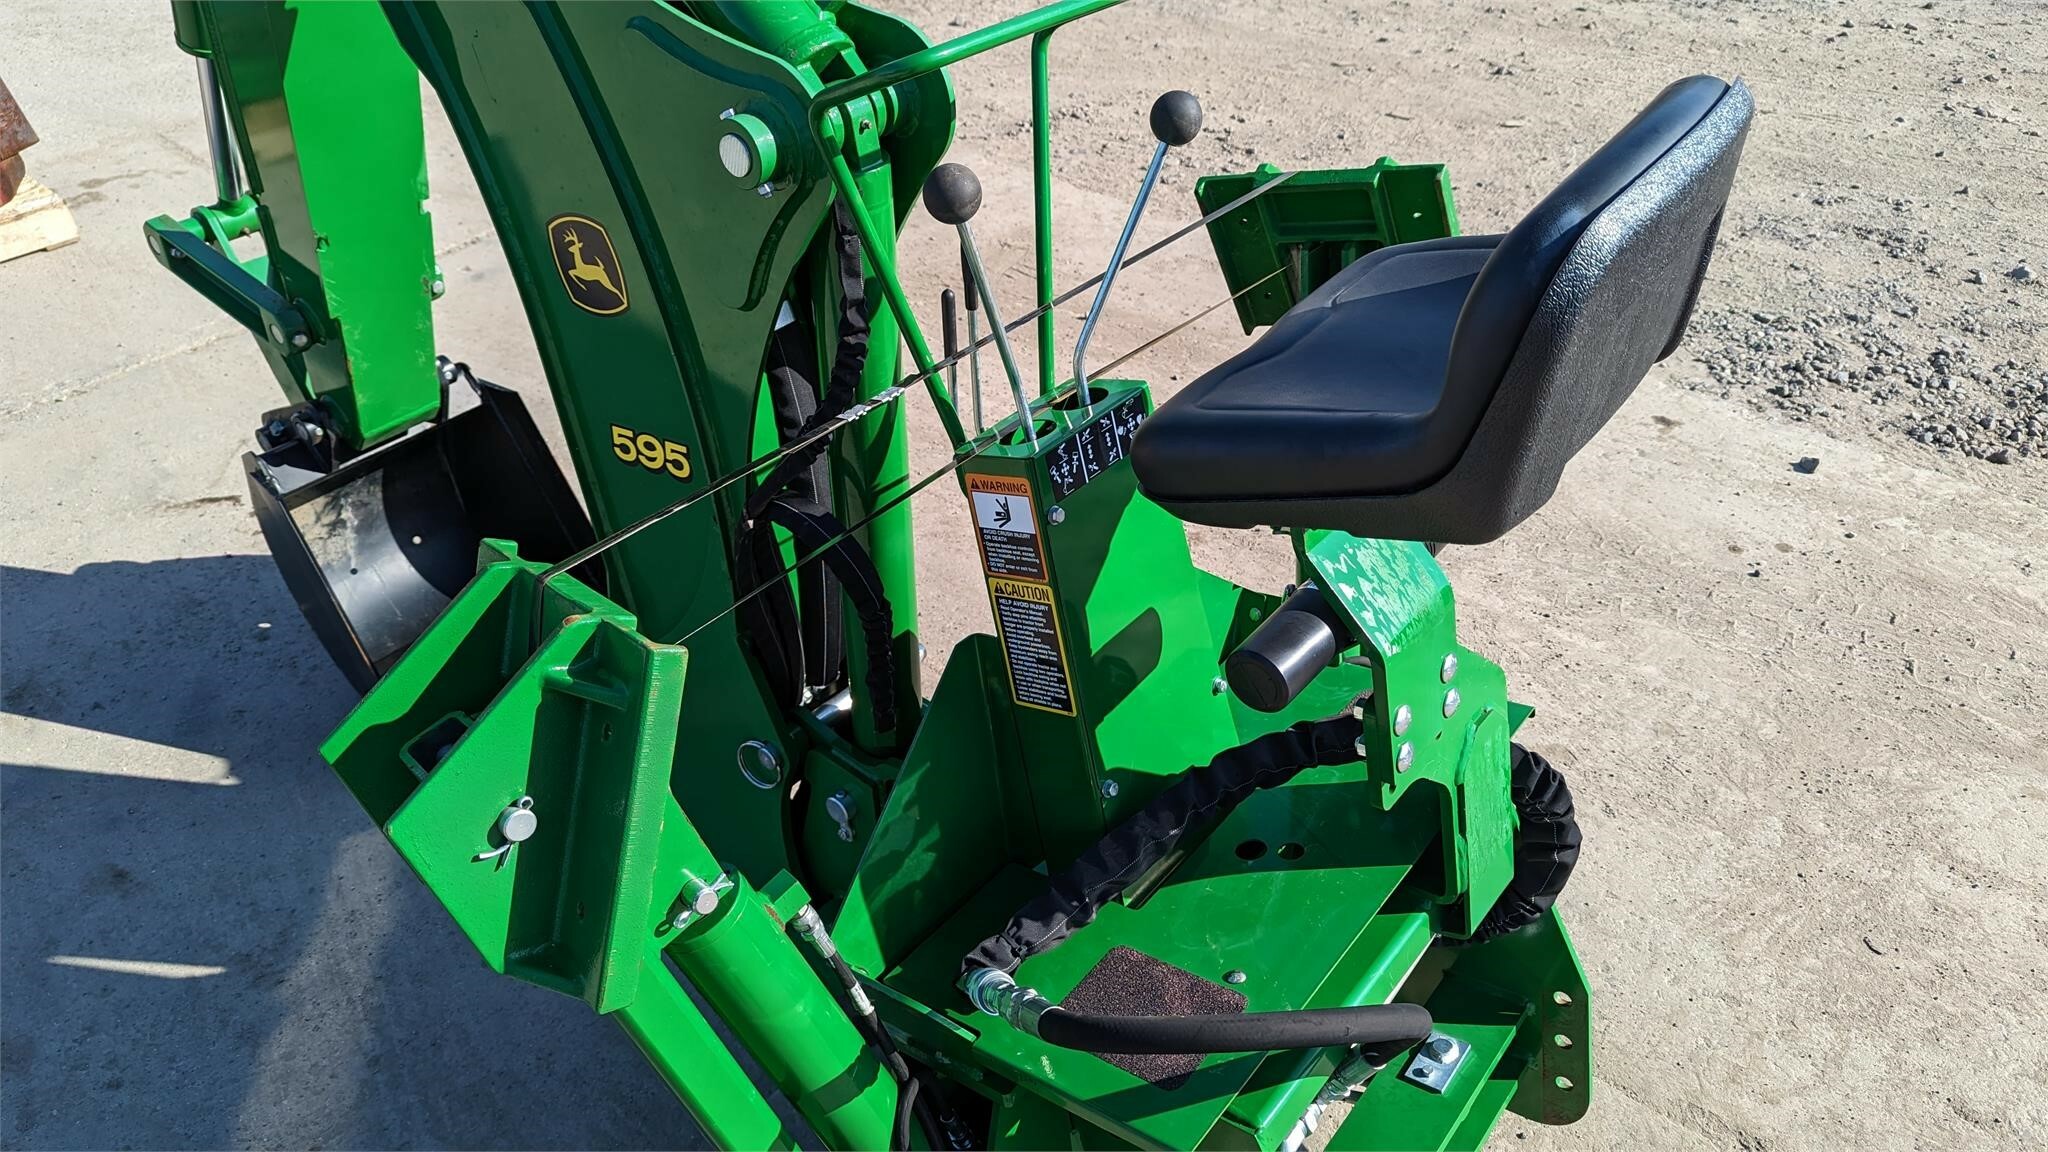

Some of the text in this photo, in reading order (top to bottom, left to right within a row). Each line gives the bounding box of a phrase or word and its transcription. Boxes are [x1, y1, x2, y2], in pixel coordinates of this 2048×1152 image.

[611, 425, 691, 479] 595
[980, 480, 1028, 494] WARNING
[1004, 583, 1050, 602] CAUTION
